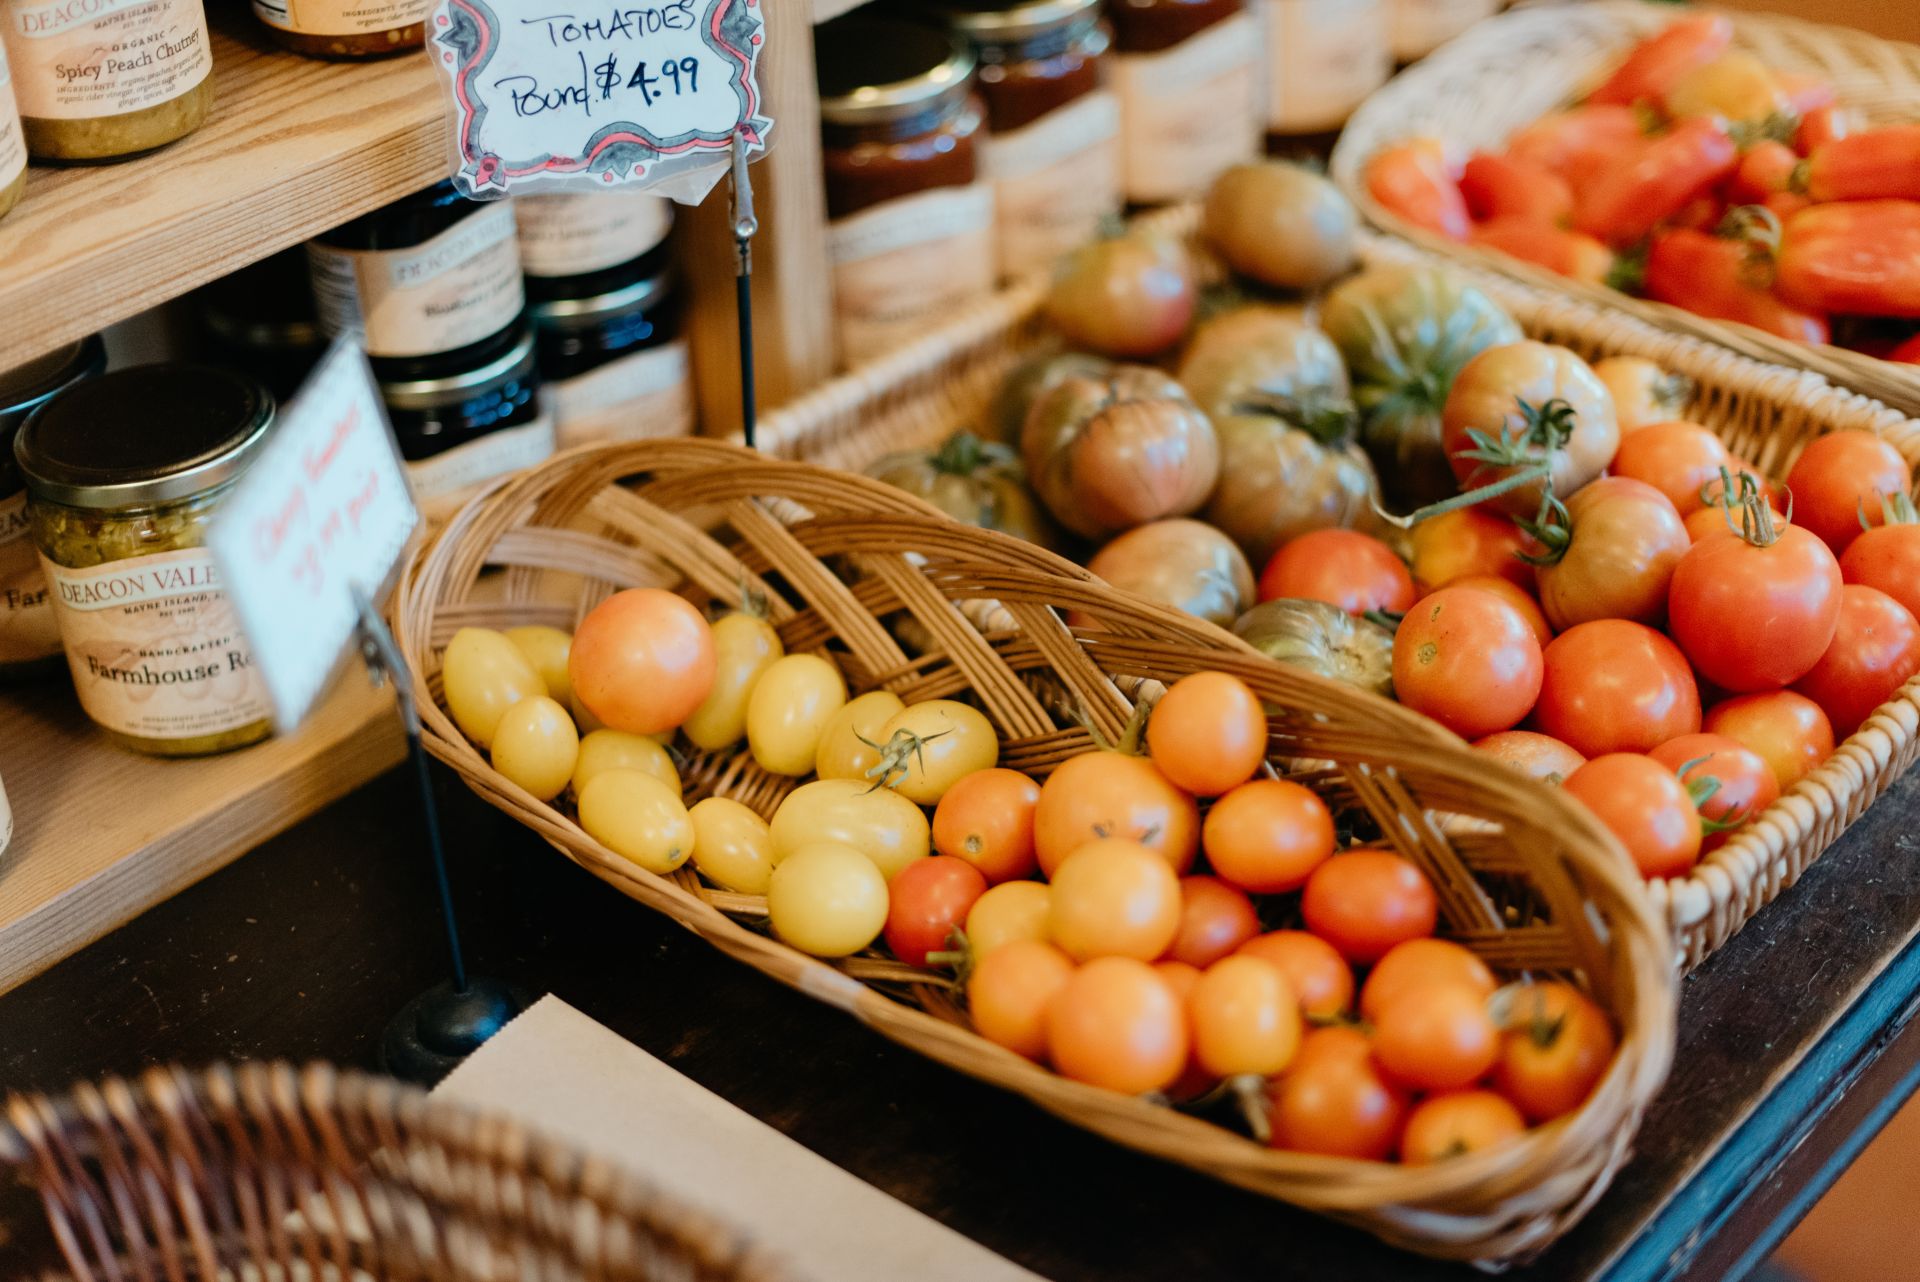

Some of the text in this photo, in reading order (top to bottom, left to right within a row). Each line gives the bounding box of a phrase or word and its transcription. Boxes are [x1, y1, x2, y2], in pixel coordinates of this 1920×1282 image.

[21, 0, 116, 33] DEACO
[94, 14, 125, 30] MAYNE
[521, 0, 696, 47] TOMATOES
[55, 63, 101, 83] Spicy
[107, 50, 153, 75] Peach
[156, 27, 200, 61] Chutney
[111, 30, 166, 53] ORGANIC
[594, 52, 699, 107] $4.99
[59, 575, 145, 604] DEACON
[123, 601, 161, 616] MAYNE
[164, 593, 211, 608] ISLAND,
[139, 636, 231, 659] HANDCRAFTED
[87, 654, 221, 687] Farmhouse
